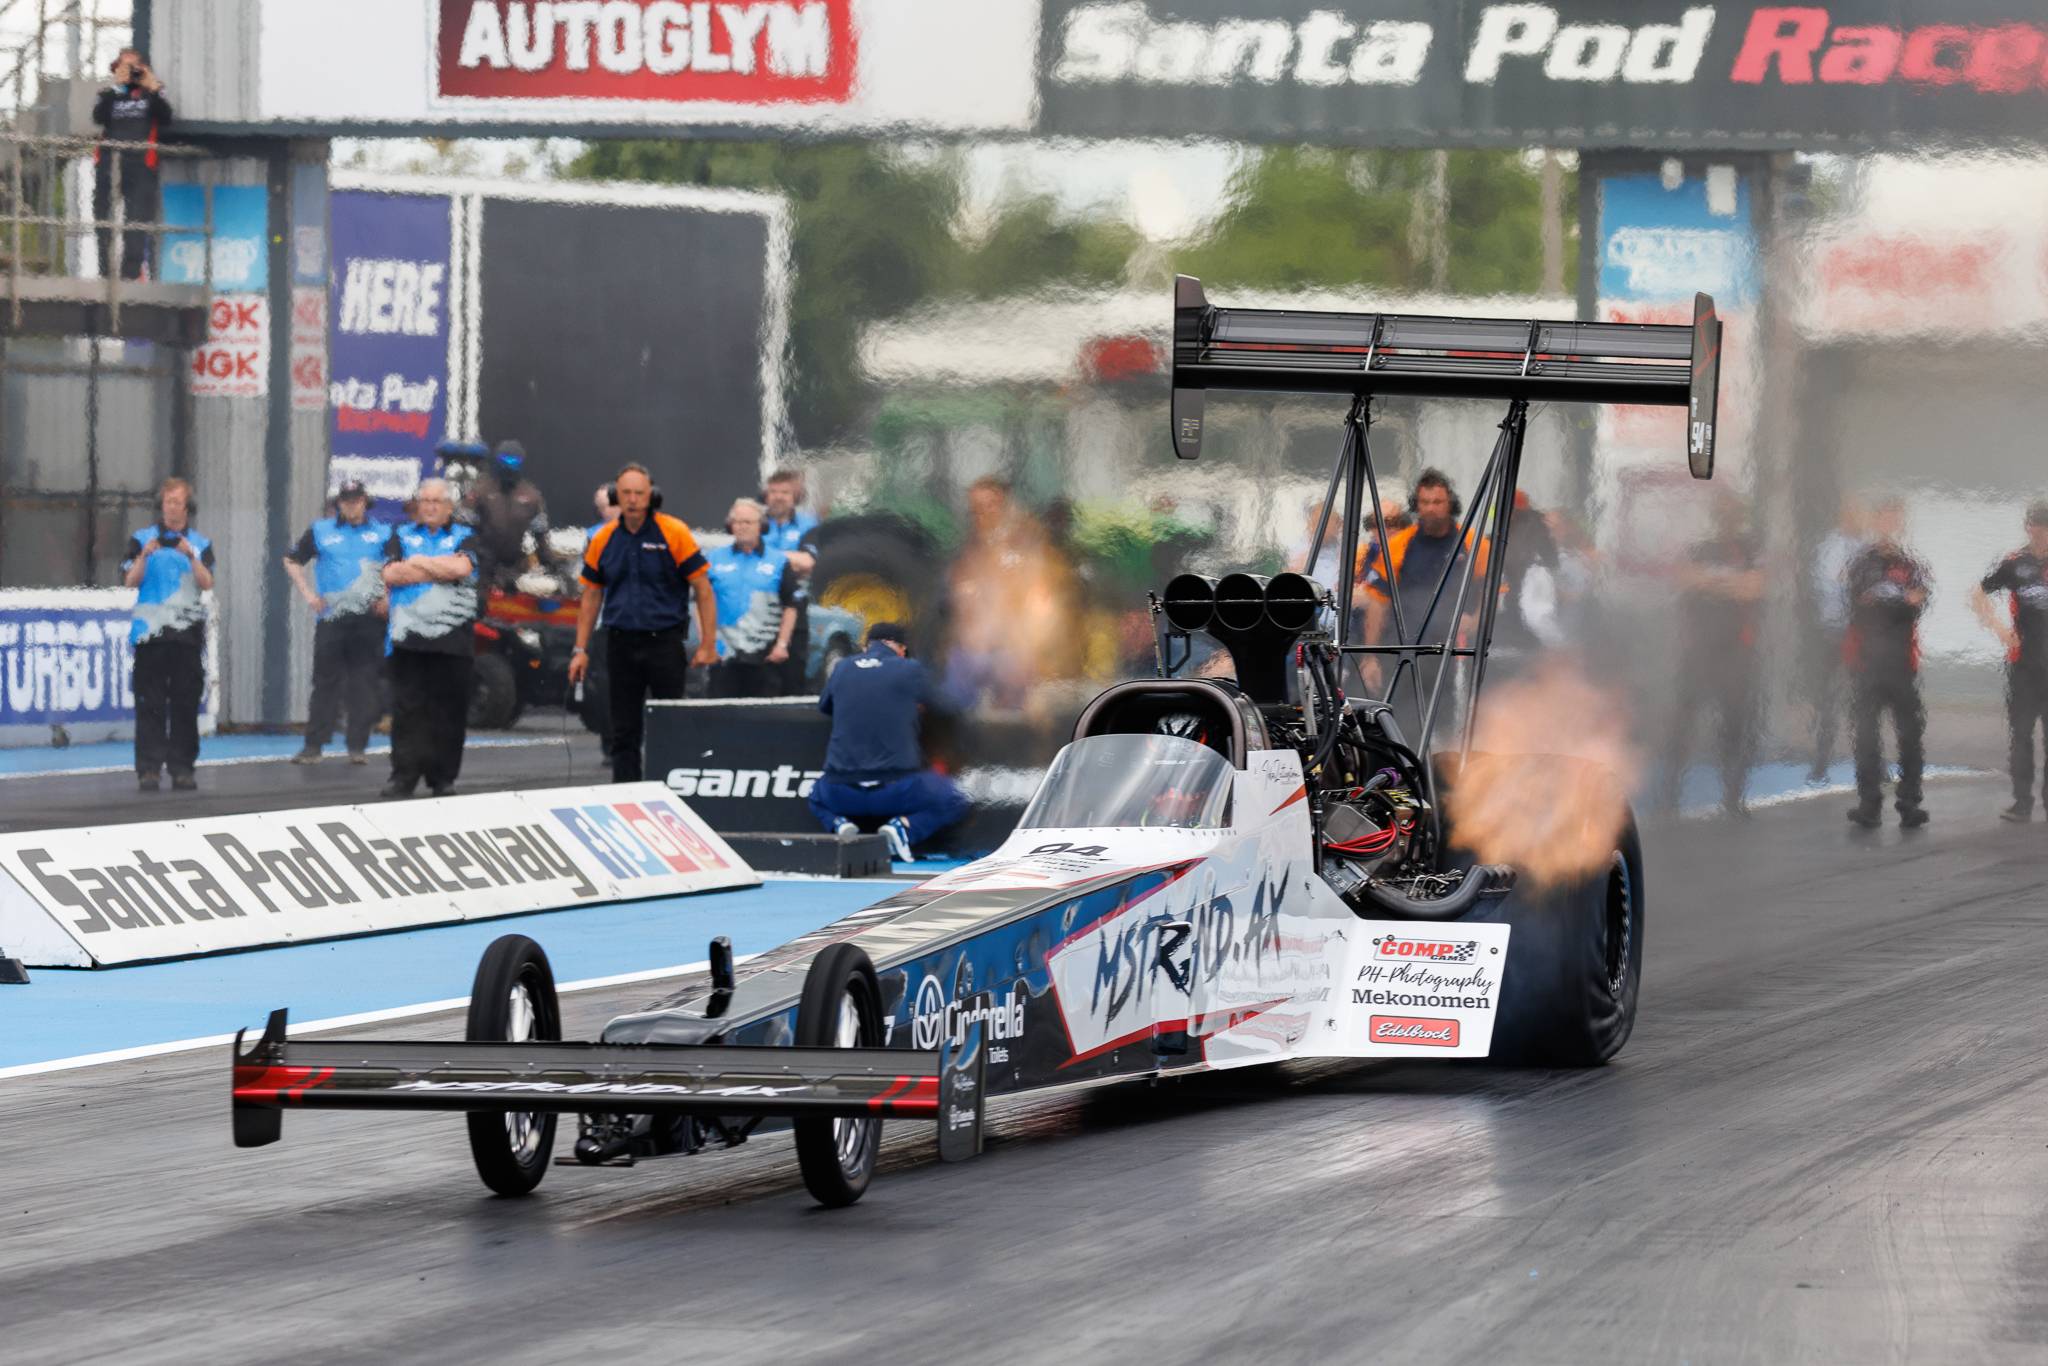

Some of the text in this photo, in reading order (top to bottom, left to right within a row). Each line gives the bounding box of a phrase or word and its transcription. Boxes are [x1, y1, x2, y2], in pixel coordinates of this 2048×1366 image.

[458, 1, 831, 82] AUTOGLYM
[1049, 1, 2048, 95] Santa Pod Race
[338, 257, 445, 336] HERE
[211, 299, 260, 331] GK
[1021, 842, 1109, 857] 94
[16, 821, 599, 934] Santa Pod Raceway
[1380, 941, 1454, 957] COMP
[1430, 954, 1468, 962] CAMS
[1357, 962, 1495, 996] PH-Photography
[1351, 988, 1491, 1010] Mekonomen
[1375, 1022, 1452, 1042] Edelbrock
